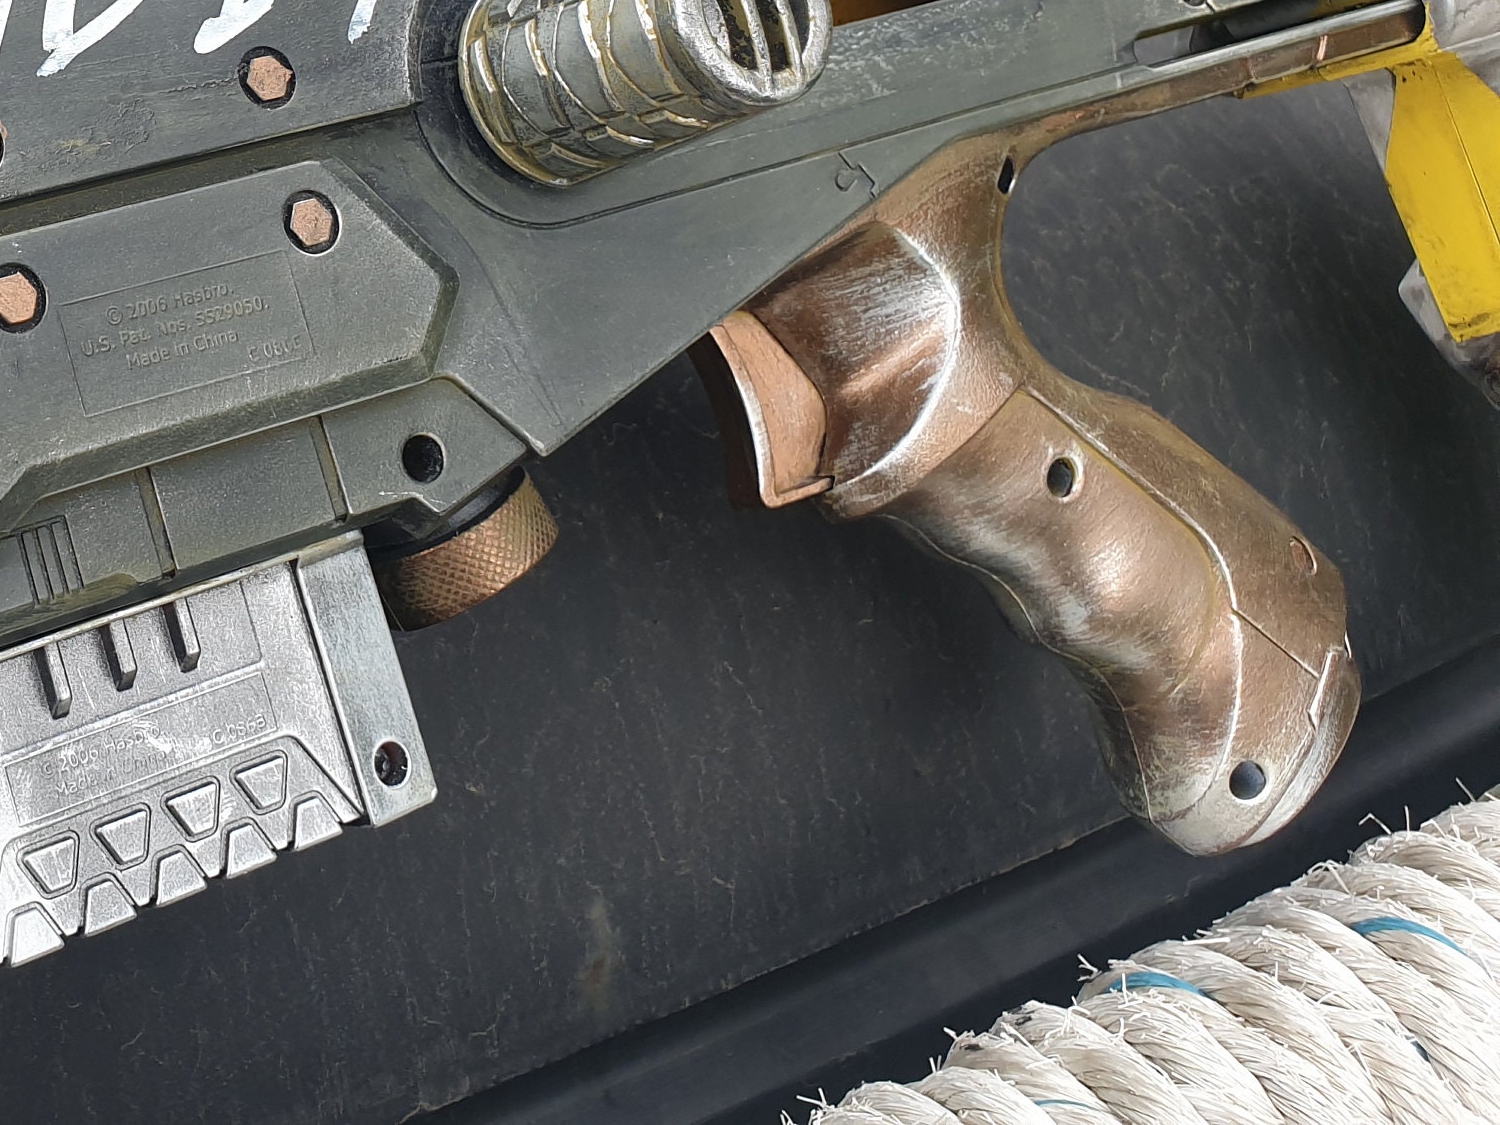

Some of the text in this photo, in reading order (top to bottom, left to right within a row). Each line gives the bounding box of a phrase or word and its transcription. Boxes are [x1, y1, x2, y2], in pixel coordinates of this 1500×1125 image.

[128, 296, 168, 320] 2006
[126, 346, 171, 370] Made
[193, 330, 239, 351] China
[58, 748, 99, 772] 2006
